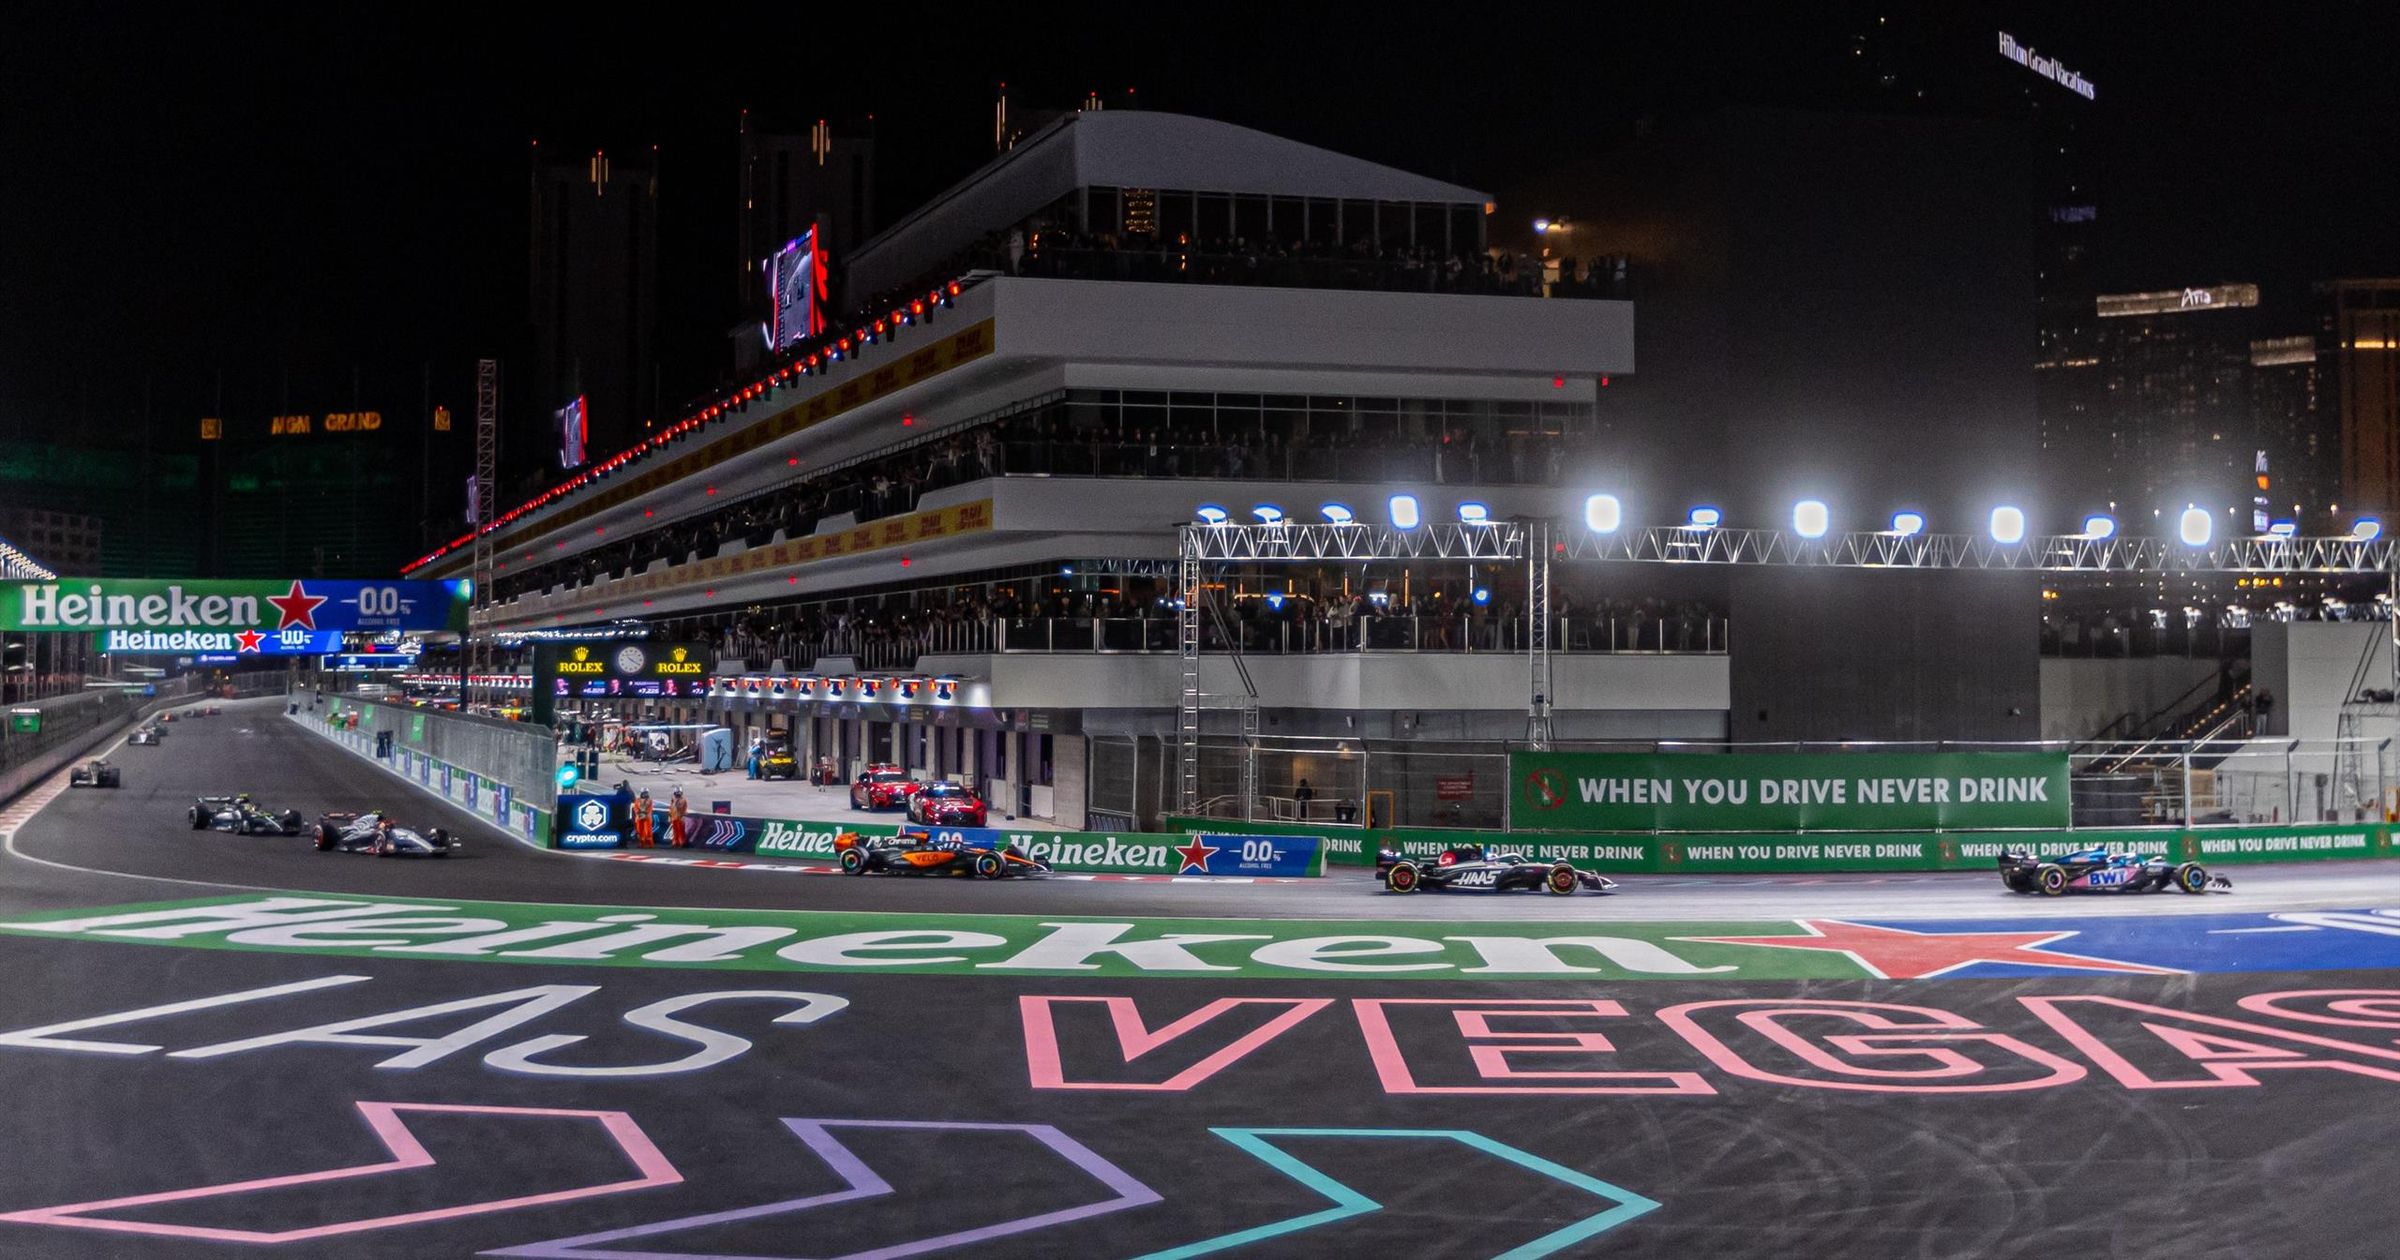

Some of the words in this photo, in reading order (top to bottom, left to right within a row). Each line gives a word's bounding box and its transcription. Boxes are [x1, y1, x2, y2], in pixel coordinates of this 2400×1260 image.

[1999, 31, 2028, 67] Hilton
[2029, 47, 2055, 80] Grand
[2055, 60, 2095, 100] Vacations
[271, 416, 311, 434] MGM
[325, 411, 381, 431] GRAND
[21, 584, 261, 626] Heineken
[109, 629, 233, 650] Heineken
[559, 662, 604, 673] ROLEX
[658, 662, 702, 673] ROLEX
[1578, 779, 1672, 804] WHEN
[1683, 779, 1748, 805] YOU
[1761, 779, 1846, 804] DRIVE
[1858, 778, 1951, 803] NEVER
[1960, 777, 2048, 802] DRINK
[566, 834, 618, 845] crypto.com
[1961, 844, 2002, 857] WHEN
[2007, 843, 2036, 855] YOU
[2041, 842, 2080, 856] DRIVE
[2126, 841, 2168, 854] DRINK
[2201, 840, 2236, 853] WHEN
[2238, 838, 2263, 851] YOU
[2265, 837, 2297, 850] DRIVE
[2300, 836, 2333, 849] NEVER
[2334, 834, 2366, 847] DRINK
[1010, 835, 1168, 867] Heineken
[1403, 841, 1448, 855] WHEN
[1540, 845, 1588, 859] NEVER
[1595, 846, 1644, 860] DRINK
[1687, 847, 1734, 860] WHEN
[1738, 846, 1771, 860] YOU
[1776, 846, 1820, 859] DRIVE
[1825, 845, 1871, 858] NEVER
[1876, 844, 1922, 857] DRINK
[1453, 870, 1501, 886] HAAS
[2090, 870, 2127, 885] BWT
[0, 896, 1739, 974] Heineken
[0, 975, 850, 1076] LAS
